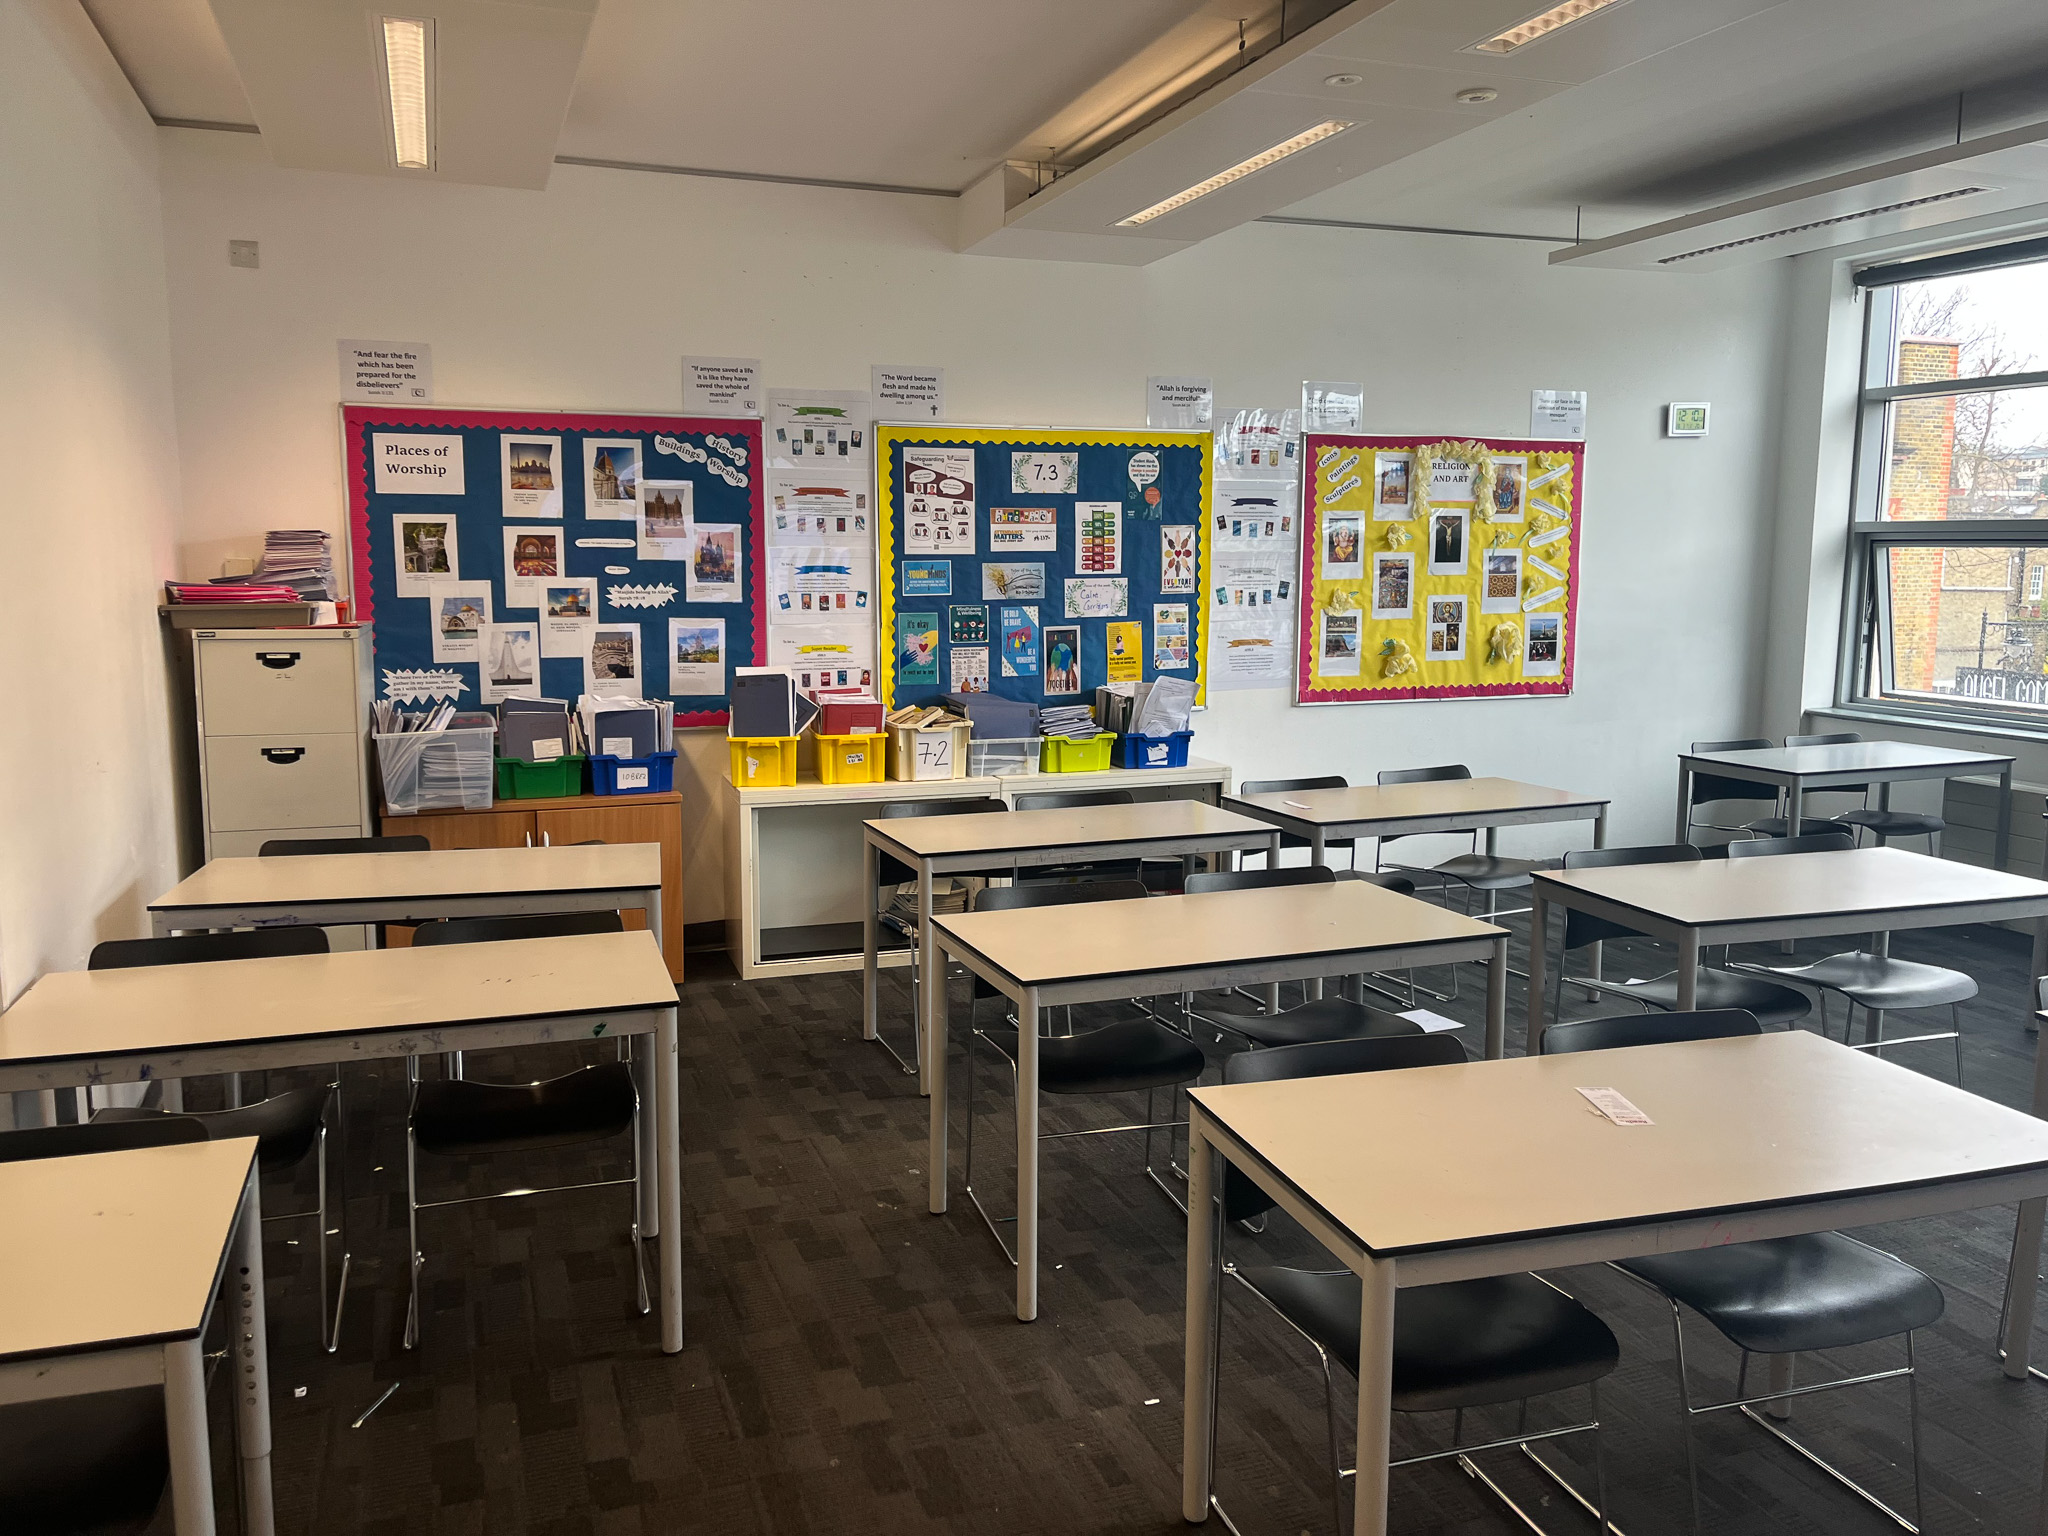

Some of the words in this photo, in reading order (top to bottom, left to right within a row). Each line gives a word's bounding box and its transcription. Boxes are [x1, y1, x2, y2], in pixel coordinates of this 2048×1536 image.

[385, 445, 430, 456] Places
[434, 446, 449, 456] of
[658, 438, 701, 459] Buildings
[712, 439, 743, 461] History
[1321, 451, 1338, 466] Icons
[385, 464, 446, 477] Worship
[710, 458, 742, 484] Worship
[1034, 464, 1058, 480] 7.3
[1329, 456, 1358, 480] Paintings
[1325, 478, 1359, 502] Sculptures
[907, 620, 915, 628] it's
[917, 621, 929, 630] okay
[918, 741, 948, 766] 7.2
